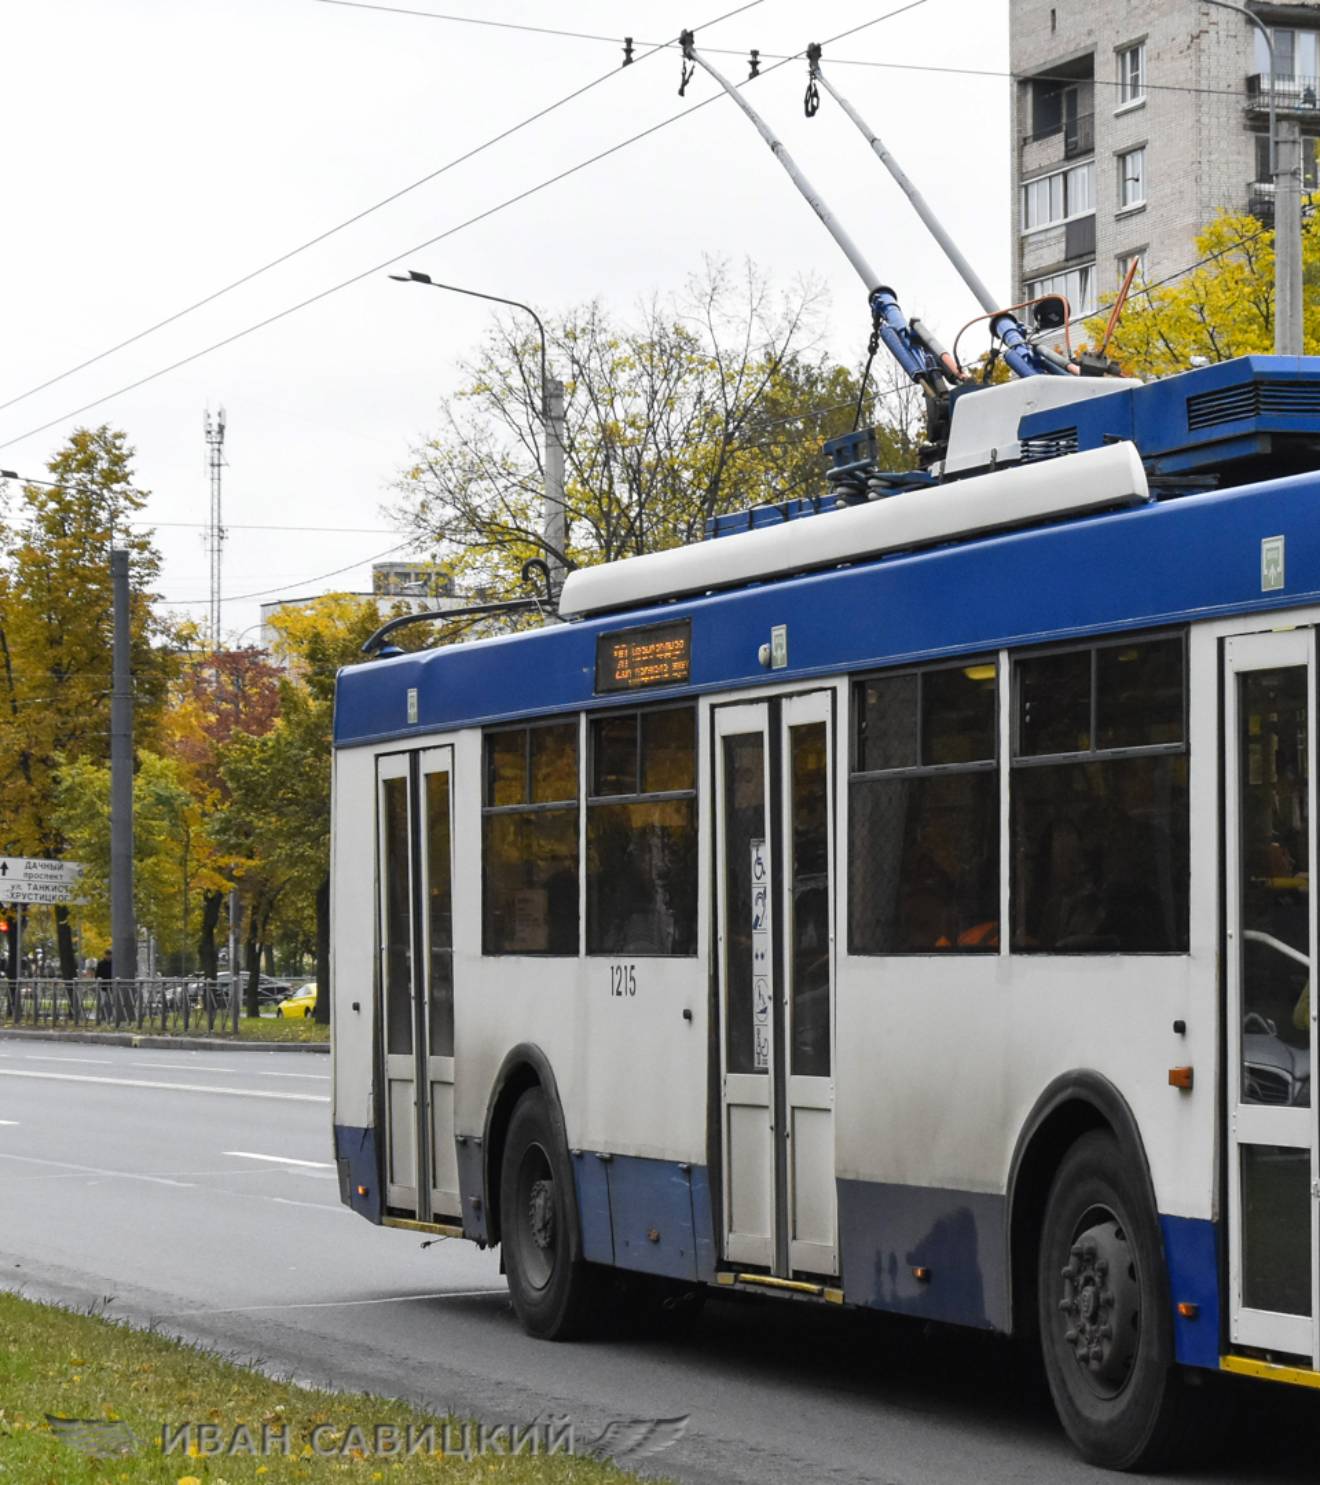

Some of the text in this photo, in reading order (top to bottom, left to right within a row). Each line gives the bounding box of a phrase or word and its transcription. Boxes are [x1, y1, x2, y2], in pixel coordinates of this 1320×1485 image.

[24, 861, 64, 872] ДАЧНЫЙ
[23, 871, 64, 881] проспект
[27, 883, 73, 895] ТАНКИСТ
[10, 891, 72, 903] ХРУСТИЦКОГ
[610, 964, 637, 997] 1215
